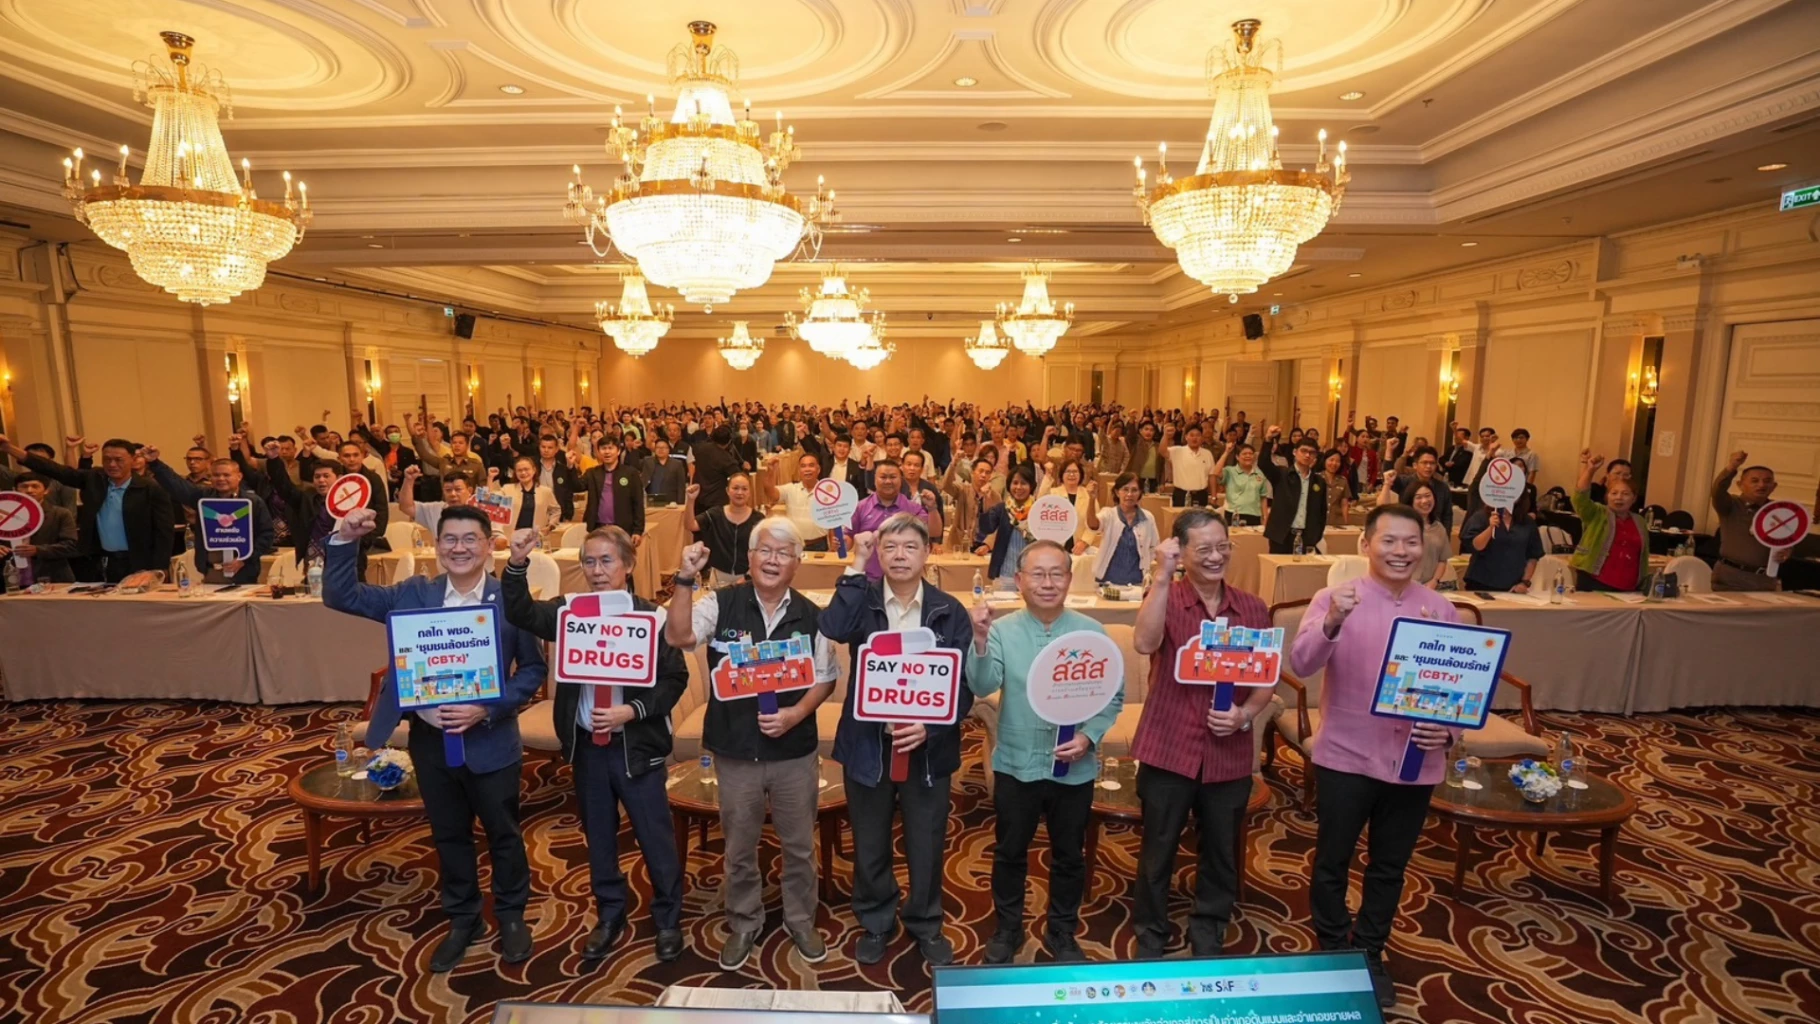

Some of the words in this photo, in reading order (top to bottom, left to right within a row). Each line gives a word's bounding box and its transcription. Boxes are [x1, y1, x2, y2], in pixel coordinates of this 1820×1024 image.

[1793, 193, 1813, 204] EXIT
[417, 626, 443, 639] กลไก
[447, 626, 474, 636] พชอ.
[566, 621, 597, 635] SAY
[600, 624, 623, 637] NO
[626, 626, 647, 639] TO
[1418, 639, 1446, 652] กลไก
[1449, 644, 1477, 656] พชอ.
[568, 648, 645, 671] DRUGS
[866, 659, 898, 673] SAY
[901, 662, 925, 675] NO
[928, 664, 950, 677] TO
[1052, 657, 1109, 682] สสส
[868, 687, 946, 708] DRUGS
